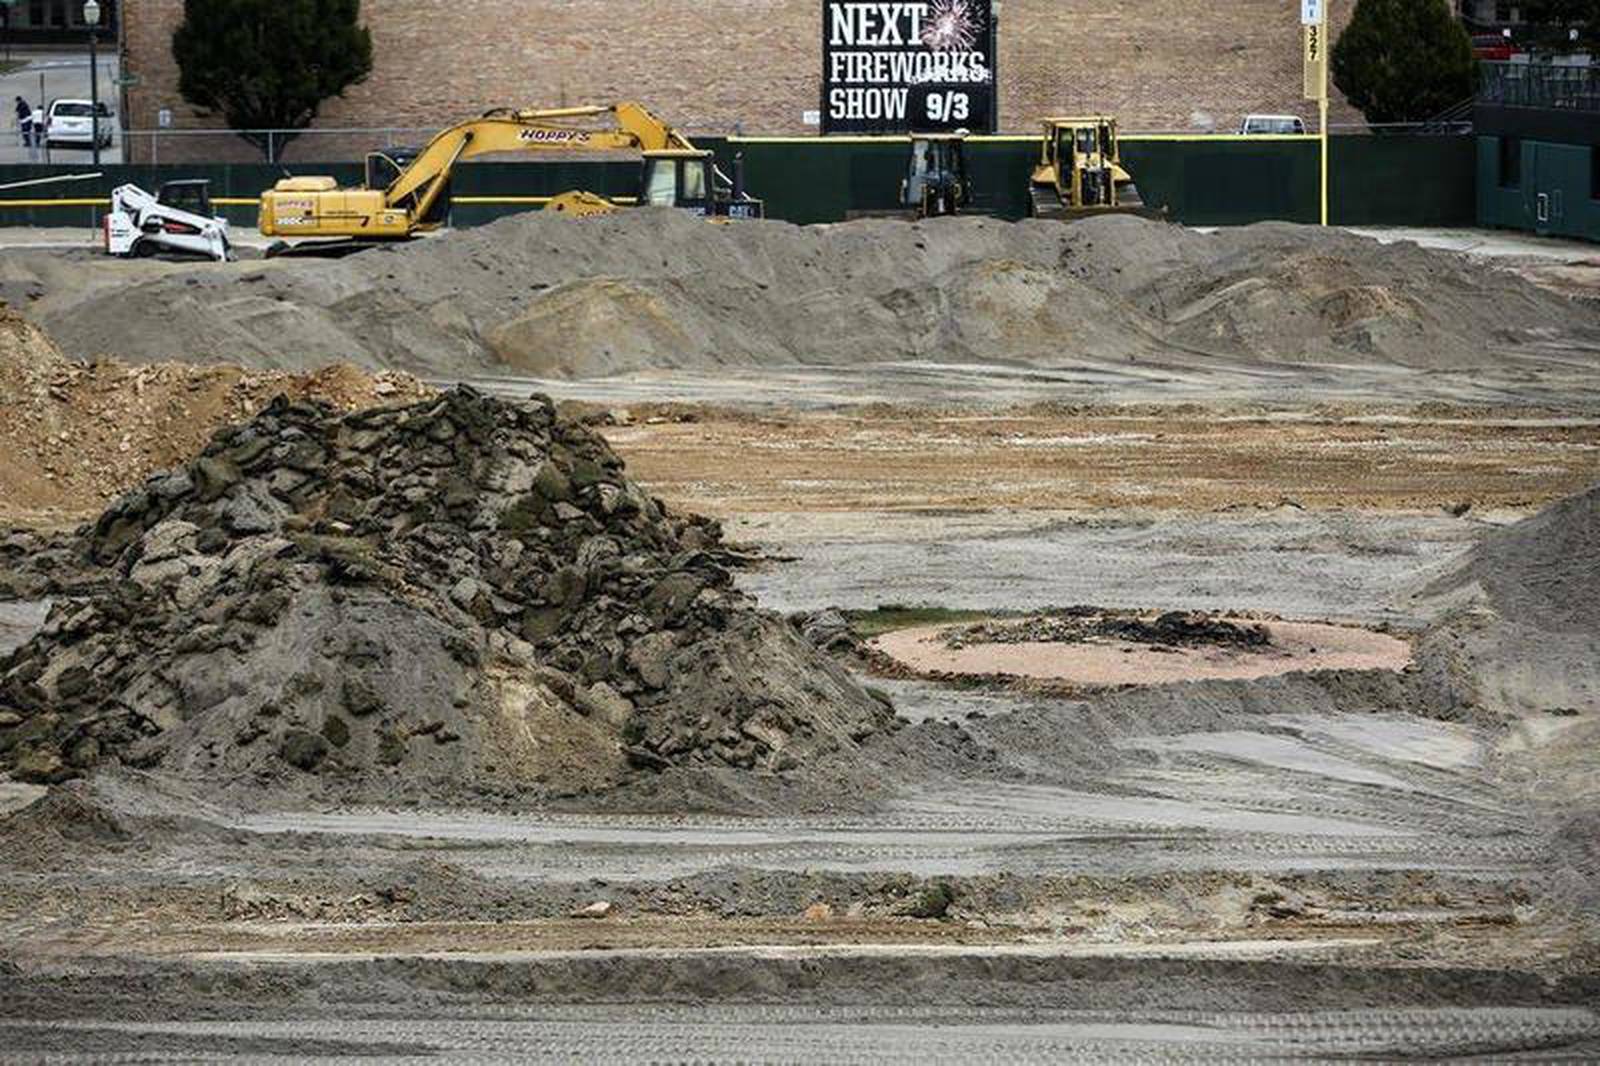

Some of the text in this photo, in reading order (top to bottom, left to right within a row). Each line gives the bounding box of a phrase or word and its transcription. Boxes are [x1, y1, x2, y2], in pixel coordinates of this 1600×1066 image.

[829, 2, 928, 46] NEXT
[829, 51, 985, 83] FIREWORKS
[829, 88, 969, 122] SHOW 9/3
